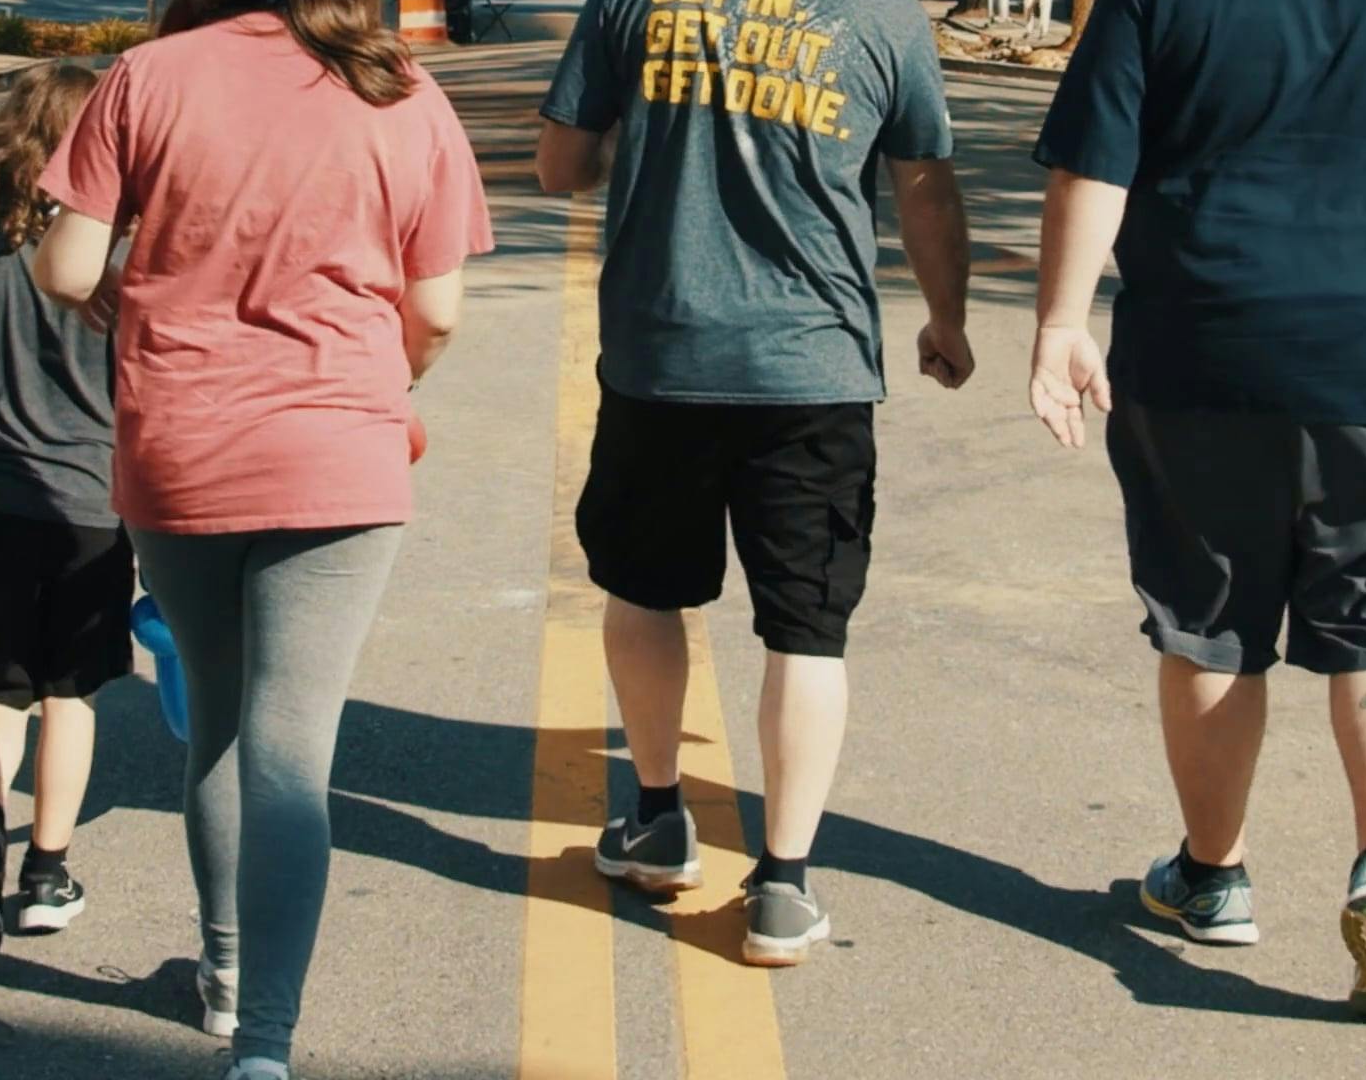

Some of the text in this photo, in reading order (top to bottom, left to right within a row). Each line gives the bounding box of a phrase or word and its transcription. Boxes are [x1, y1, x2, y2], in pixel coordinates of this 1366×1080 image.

[646, 9, 838, 84] GET OUT.
[723, 67, 852, 141] DONE.
